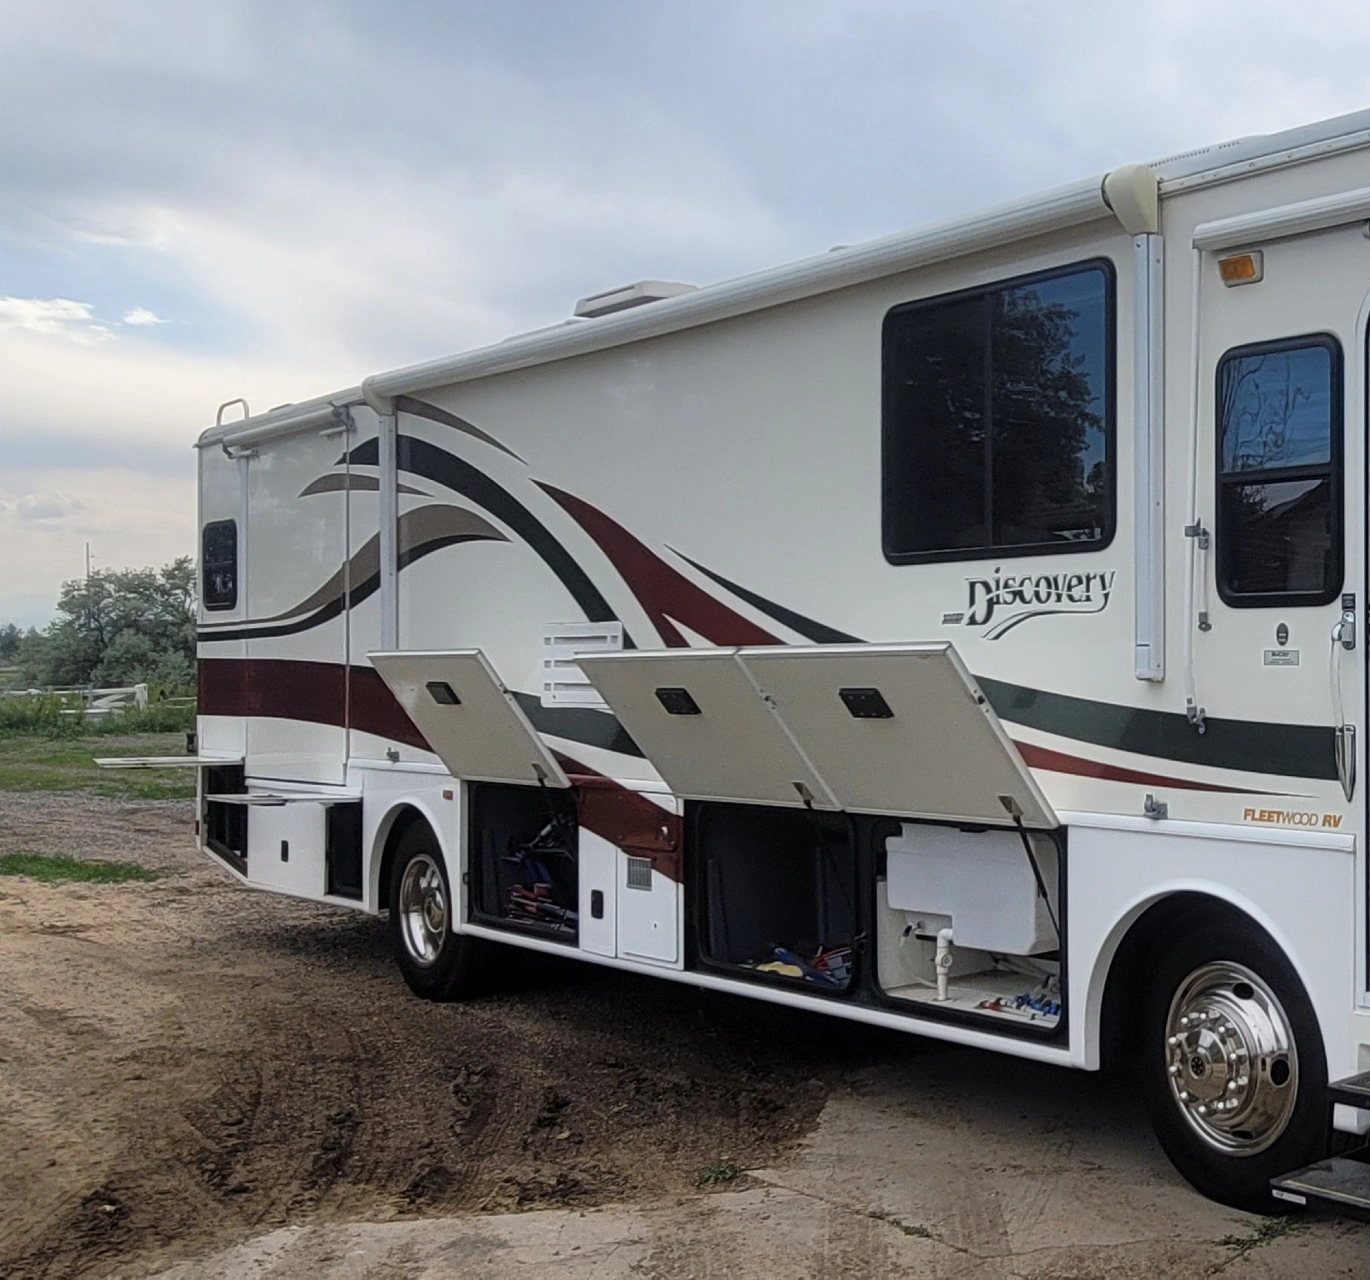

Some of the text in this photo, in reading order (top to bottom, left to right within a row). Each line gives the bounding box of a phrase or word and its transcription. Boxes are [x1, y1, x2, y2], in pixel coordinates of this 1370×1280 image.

[964, 566, 1117, 628] Discovery
[1243, 807, 1343, 829] FLEETWOOD RV
